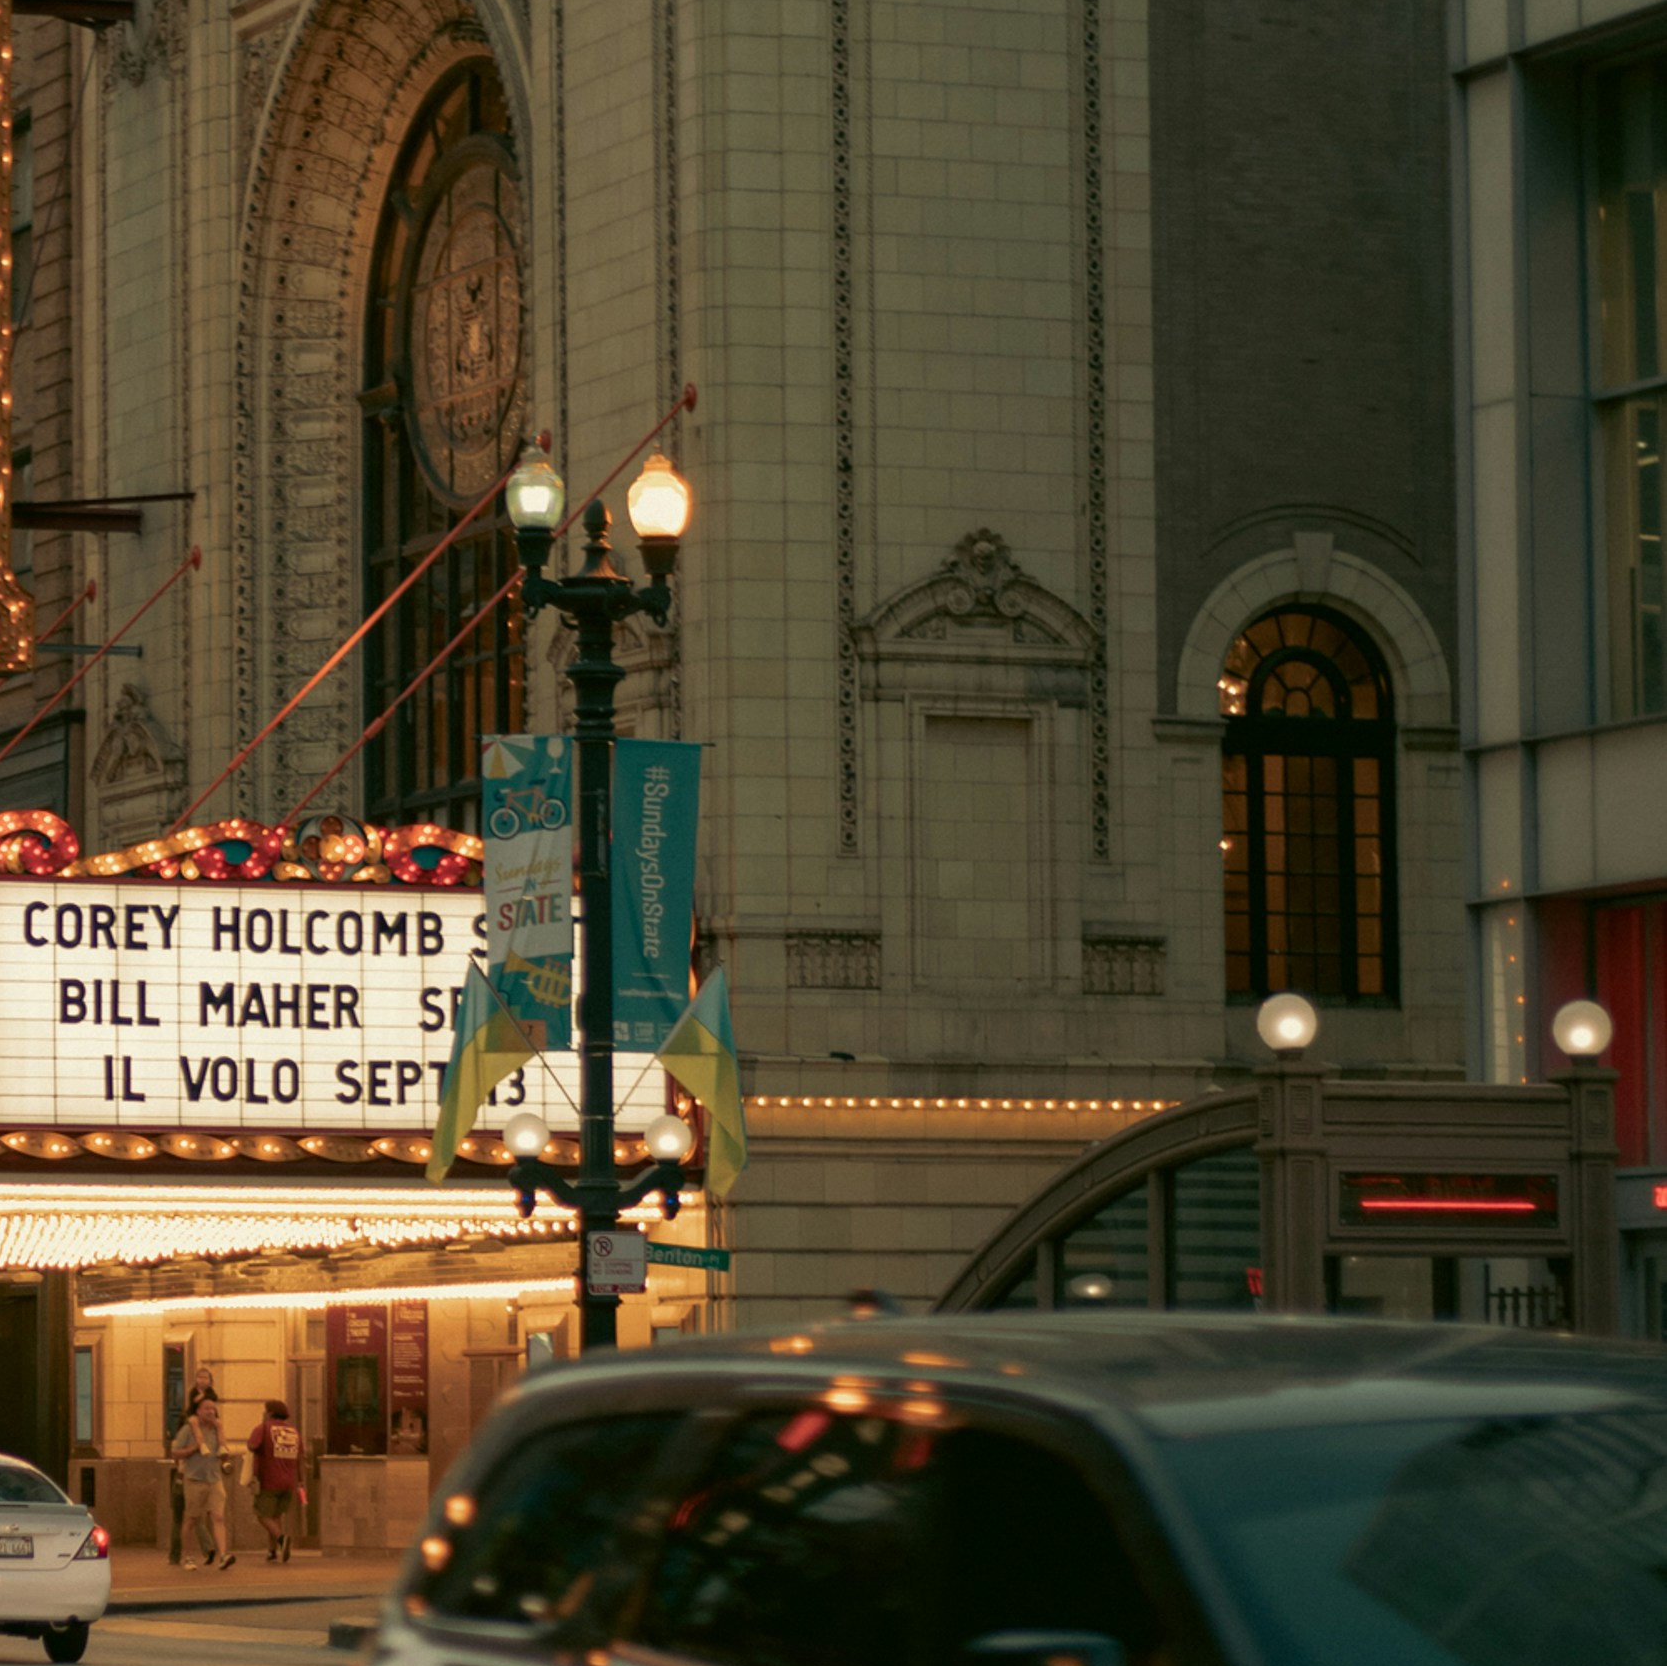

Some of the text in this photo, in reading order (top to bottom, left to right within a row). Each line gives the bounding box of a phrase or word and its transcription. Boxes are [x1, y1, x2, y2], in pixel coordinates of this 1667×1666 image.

[635, 765, 670, 959] #SundaysOnState
[23, 900, 181, 951] COREY
[212, 905, 444, 956] HOLCOMB
[497, 893, 563, 932] STATE
[59, 978, 161, 1027] BILL
[199, 982, 362, 1030] MAHER
[104, 1055, 146, 1102] IL
[180, 1056, 300, 1104] VOLO
[335, 1059, 449, 1106] SEPT
[646, 1245, 703, 1266] Benton
